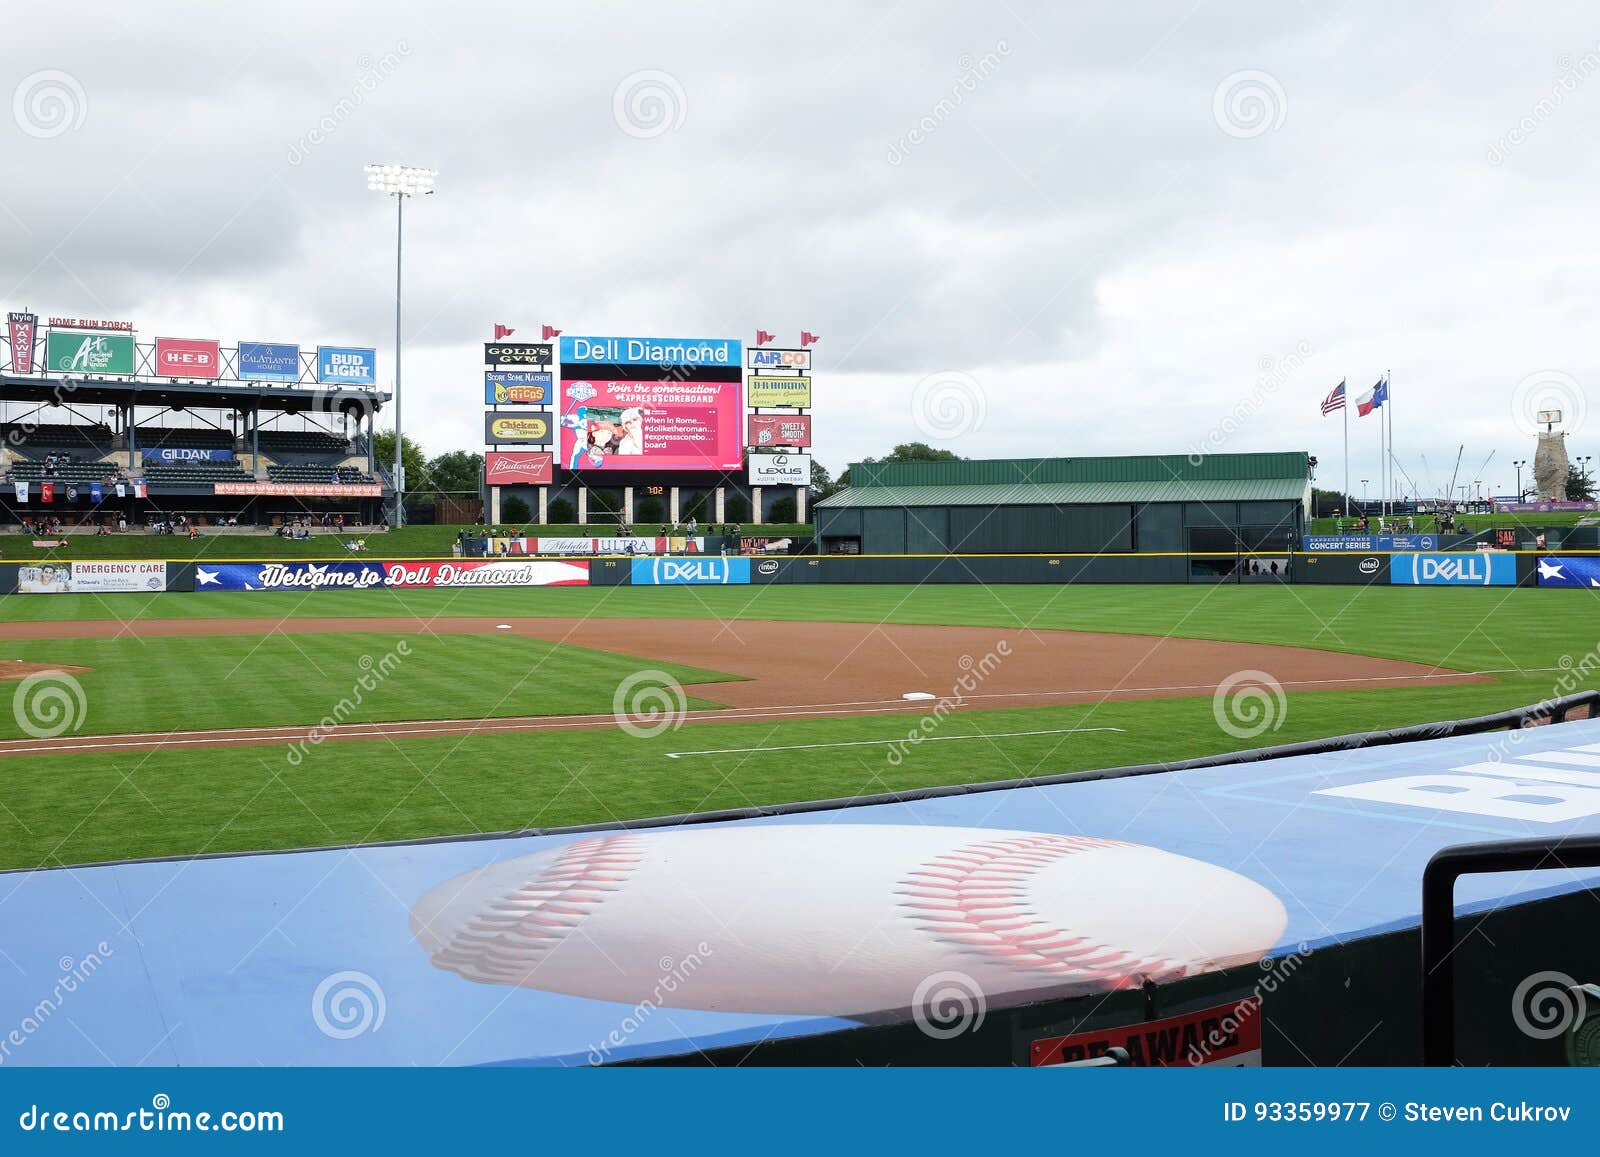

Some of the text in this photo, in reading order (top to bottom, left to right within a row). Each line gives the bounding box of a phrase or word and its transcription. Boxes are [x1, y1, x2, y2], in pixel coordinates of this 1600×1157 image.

[12, 313, 32, 322] Nyle
[49, 317, 133, 331] HOME RUN PORCH
[15, 323, 30, 372] MAXWELL
[488, 347, 550, 356] GOLD'S
[574, 339, 729, 362] Dell Diamond
[331, 353, 364, 366] BUD
[500, 355, 538, 363] GYM
[325, 364, 370, 377] LIGHT
[607, 382, 632, 393] Join
[634, 383, 651, 393] the
[500, 421, 539, 429] Chicken
[781, 422, 800, 430] SWEET
[781, 430, 804, 438] SMOOTH
[162, 449, 210, 460] GILDAN
[495, 460, 544, 471] Budweiser
[601, 539, 649, 551] ULTRA
[1309, 542, 1344, 550] CONCERT
[75, 564, 165, 574] EMERGENCY CARE
[258, 565, 532, 587] Welcome to Dell Diamond
